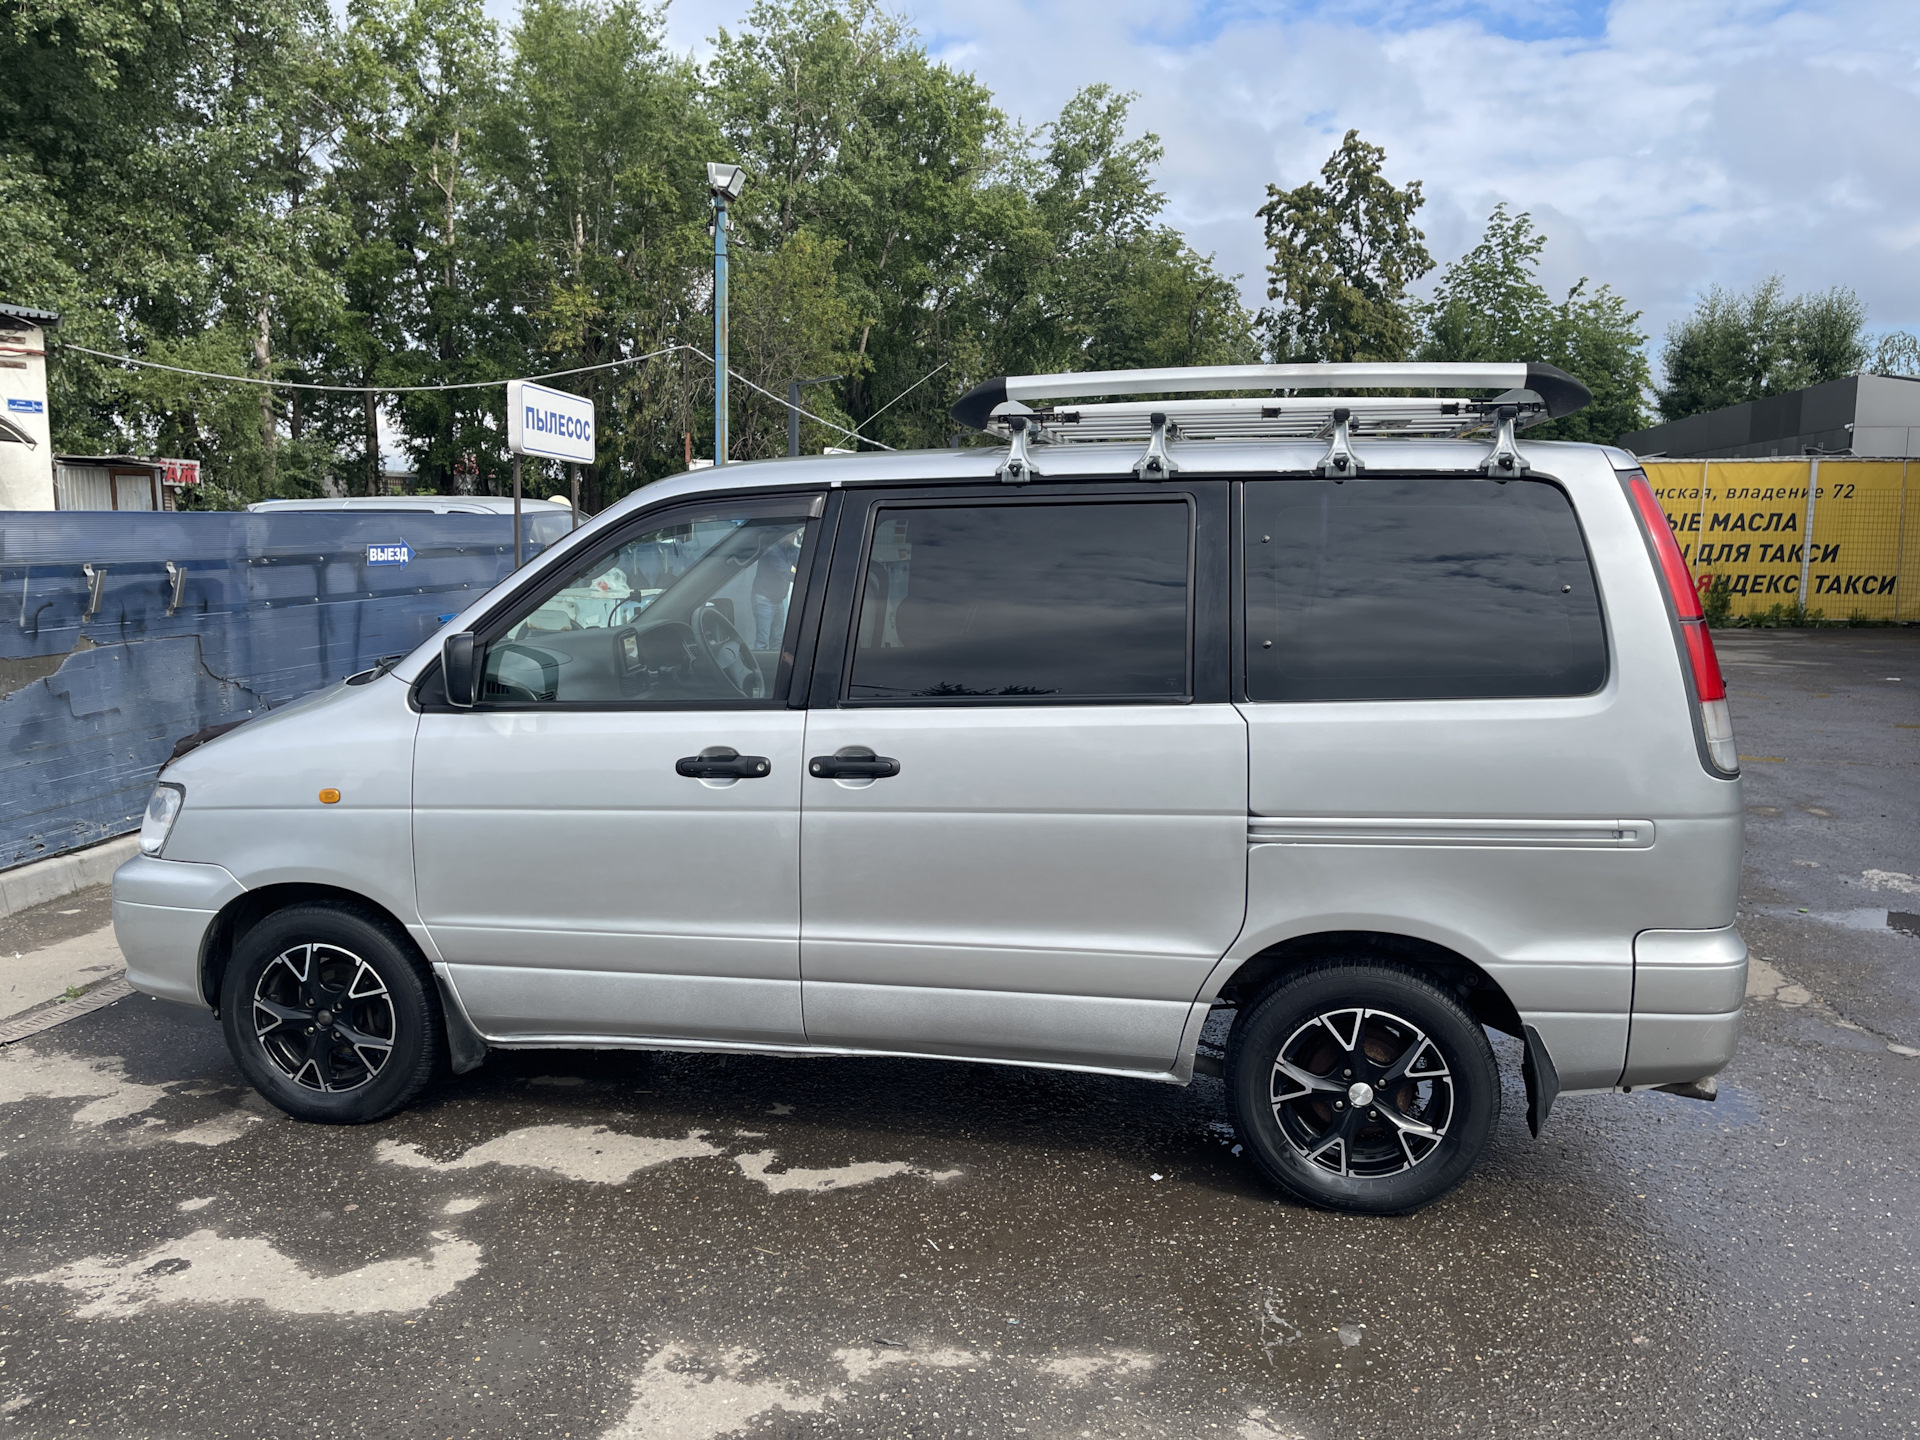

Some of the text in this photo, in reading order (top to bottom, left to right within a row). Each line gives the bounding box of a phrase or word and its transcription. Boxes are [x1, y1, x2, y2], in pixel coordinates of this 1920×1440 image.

[525, 405, 591, 442] ПЫЛЕСОС
[158, 461, 198, 483] АЖ
[1725, 487, 1824, 501] владение
[1832, 483, 1855, 499] 72
[1709, 513, 1798, 532] МАСЛА
[369, 547, 409, 562] ВЫЕЗД
[1693, 544, 1752, 566] ДЛЯ
[1759, 544, 1841, 563] ТАКСИ
[1815, 575, 1897, 595] ТАКСИ
